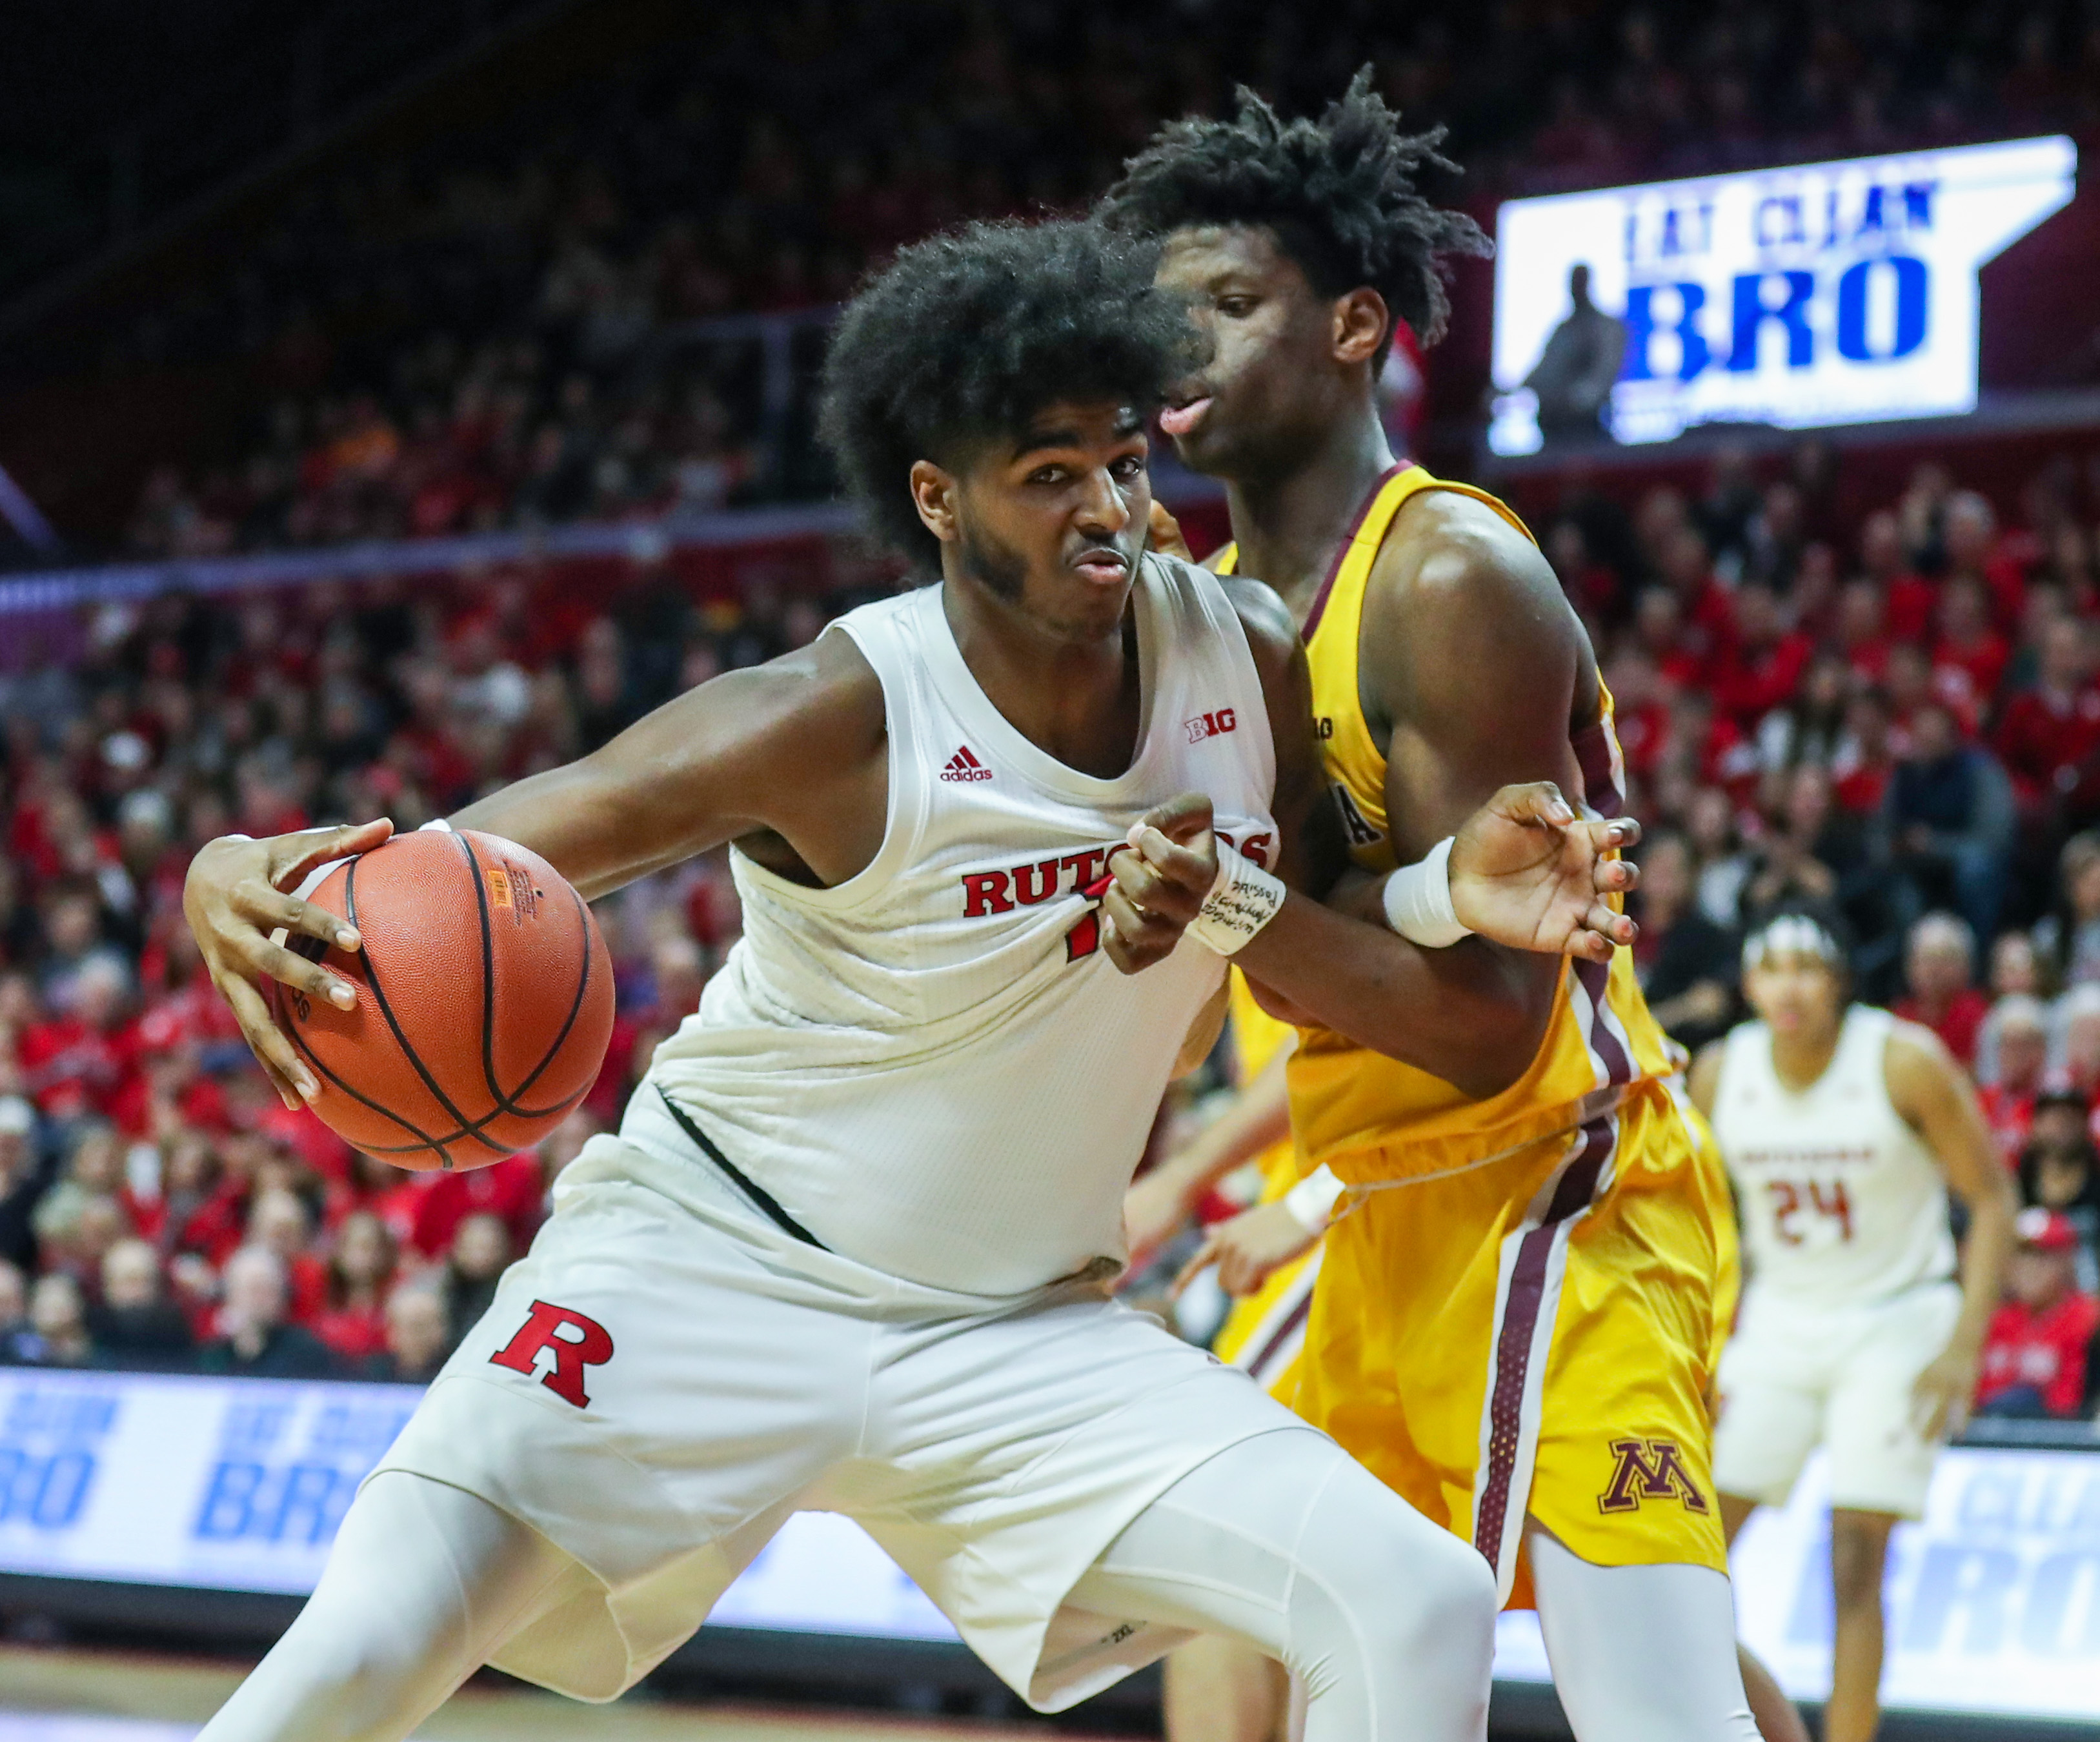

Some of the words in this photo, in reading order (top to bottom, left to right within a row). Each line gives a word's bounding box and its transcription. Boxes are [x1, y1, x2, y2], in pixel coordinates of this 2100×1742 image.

[1623, 257, 1928, 382] BRO
[940, 768, 993, 782] adidas
[962, 831, 1273, 919] RUTS
[1764, 1179, 1853, 1247] 24
[489, 1299, 614, 1410] R
[1598, 1439, 1709, 1515] M
